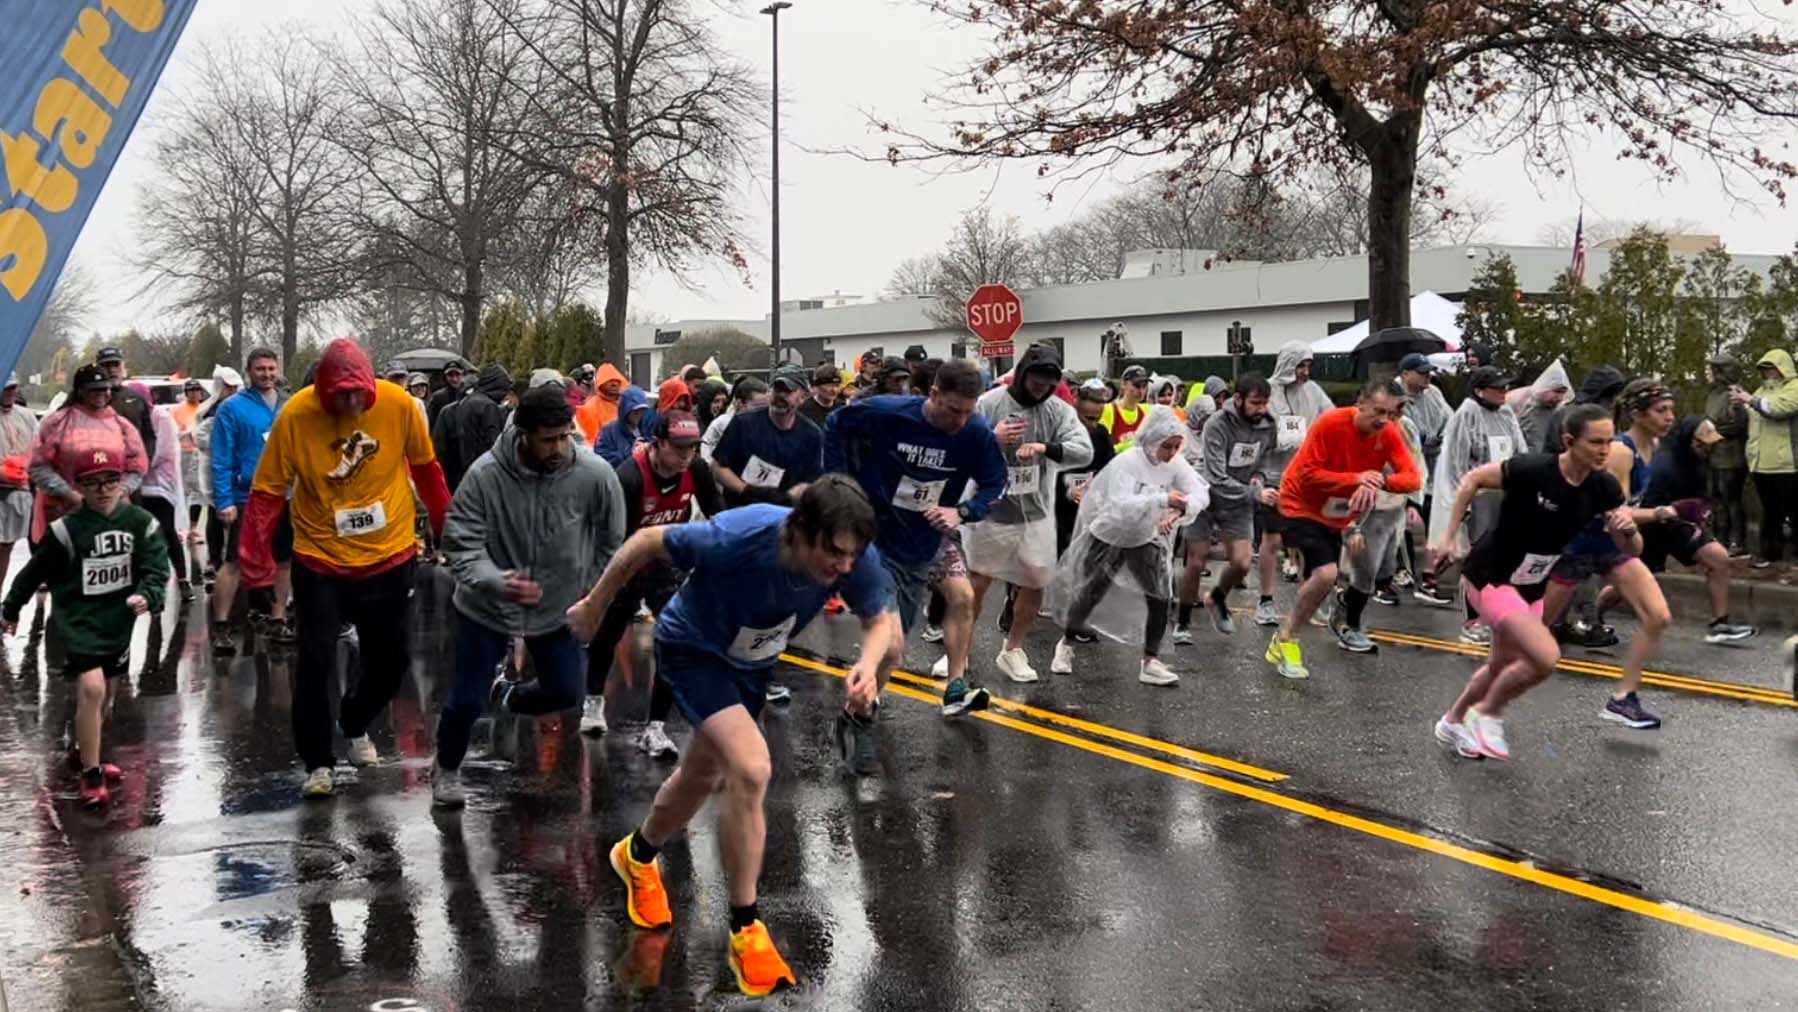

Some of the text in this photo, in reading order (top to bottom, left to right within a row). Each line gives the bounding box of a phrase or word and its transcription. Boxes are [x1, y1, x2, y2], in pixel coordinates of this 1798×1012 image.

[970, 302, 1018, 326] STOP
[897, 442, 924, 455] WHAT
[906, 453, 917, 464] IT
[349, 513, 375, 529] 139
[90, 530, 134, 557] JETS
[87, 564, 128, 586] 2004
